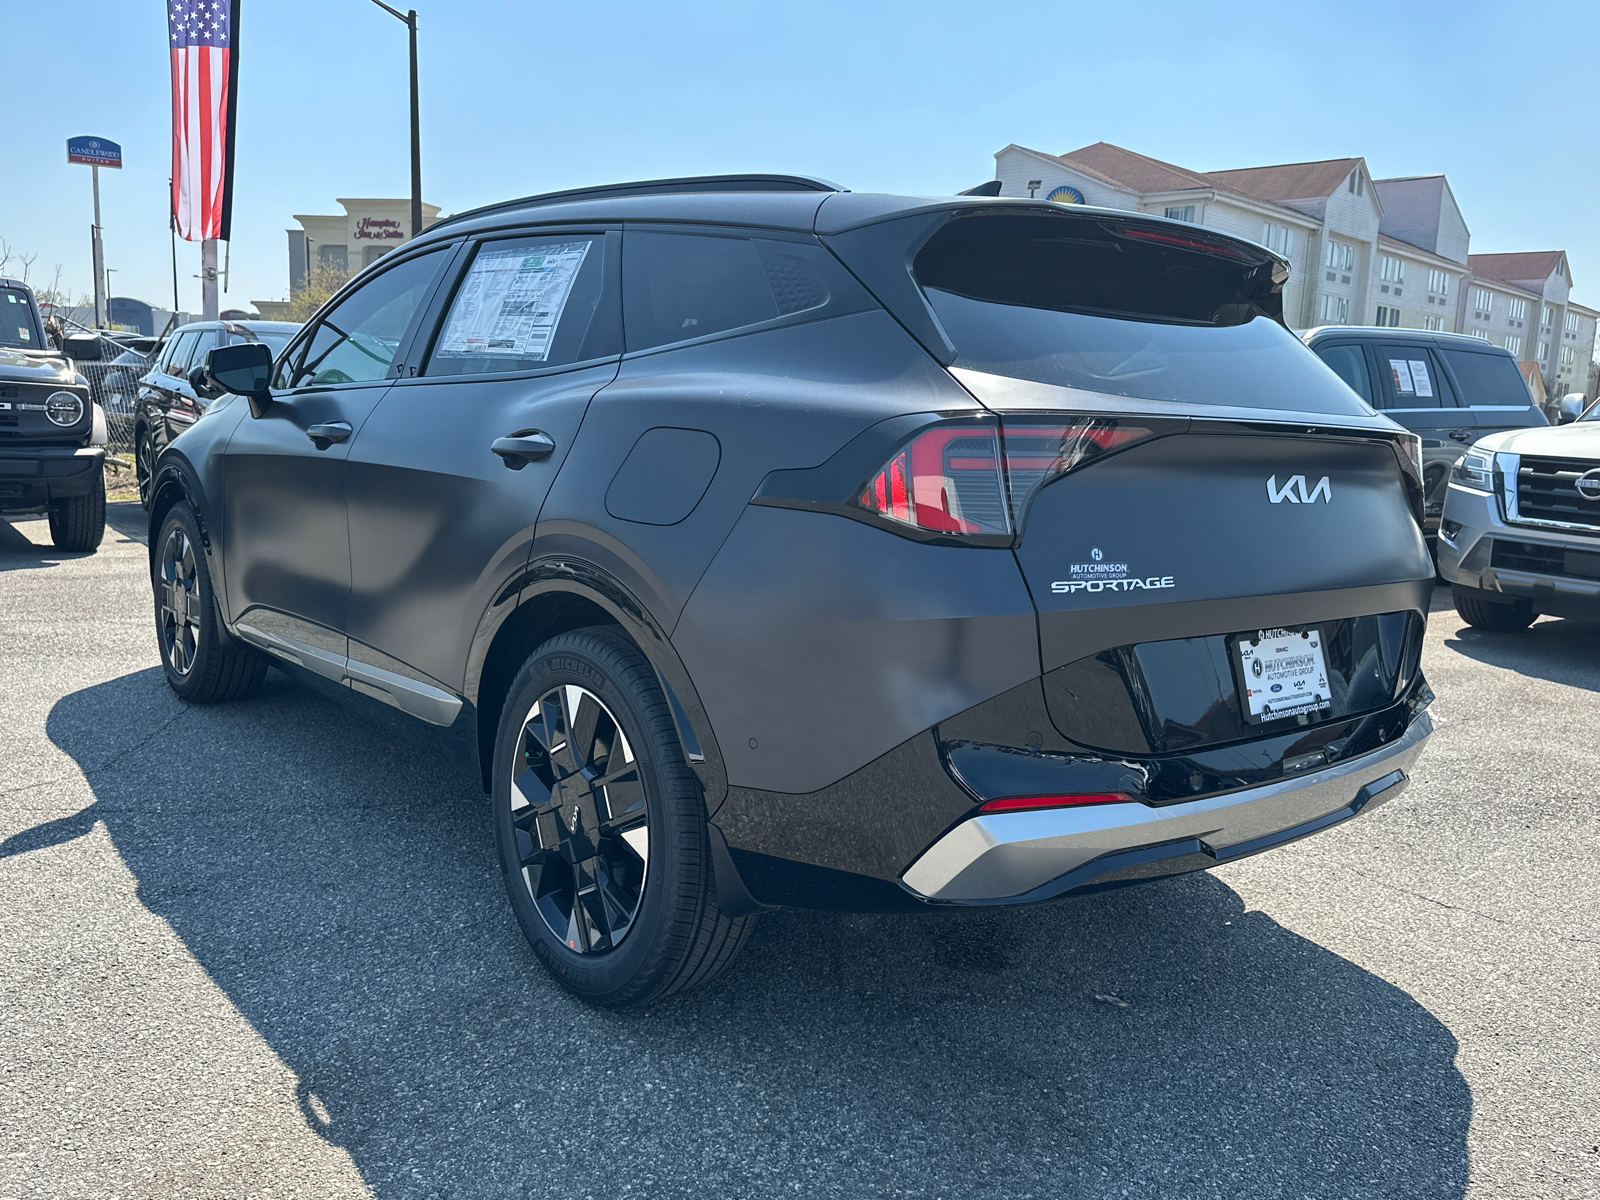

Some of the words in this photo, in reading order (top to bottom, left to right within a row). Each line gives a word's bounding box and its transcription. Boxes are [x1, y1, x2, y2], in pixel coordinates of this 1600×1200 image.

[70, 146, 120, 158] CANDLEWOOD
[356, 216, 401, 230] Hampton
[1266, 474, 1332, 504] KIA
[1070, 564, 1127, 573] HUTCHINSON
[1051, 576, 1175, 593] SPORTAGE
[1265, 654, 1314, 672] HUTCHINSON
[551, 658, 605, 687] MICHELIN
[1267, 670, 1298, 680] AUTOMOTIVE
[1299, 667, 1314, 675] GROUP
[1260, 701, 1331, 722] Hutchinsonautogroup.com
